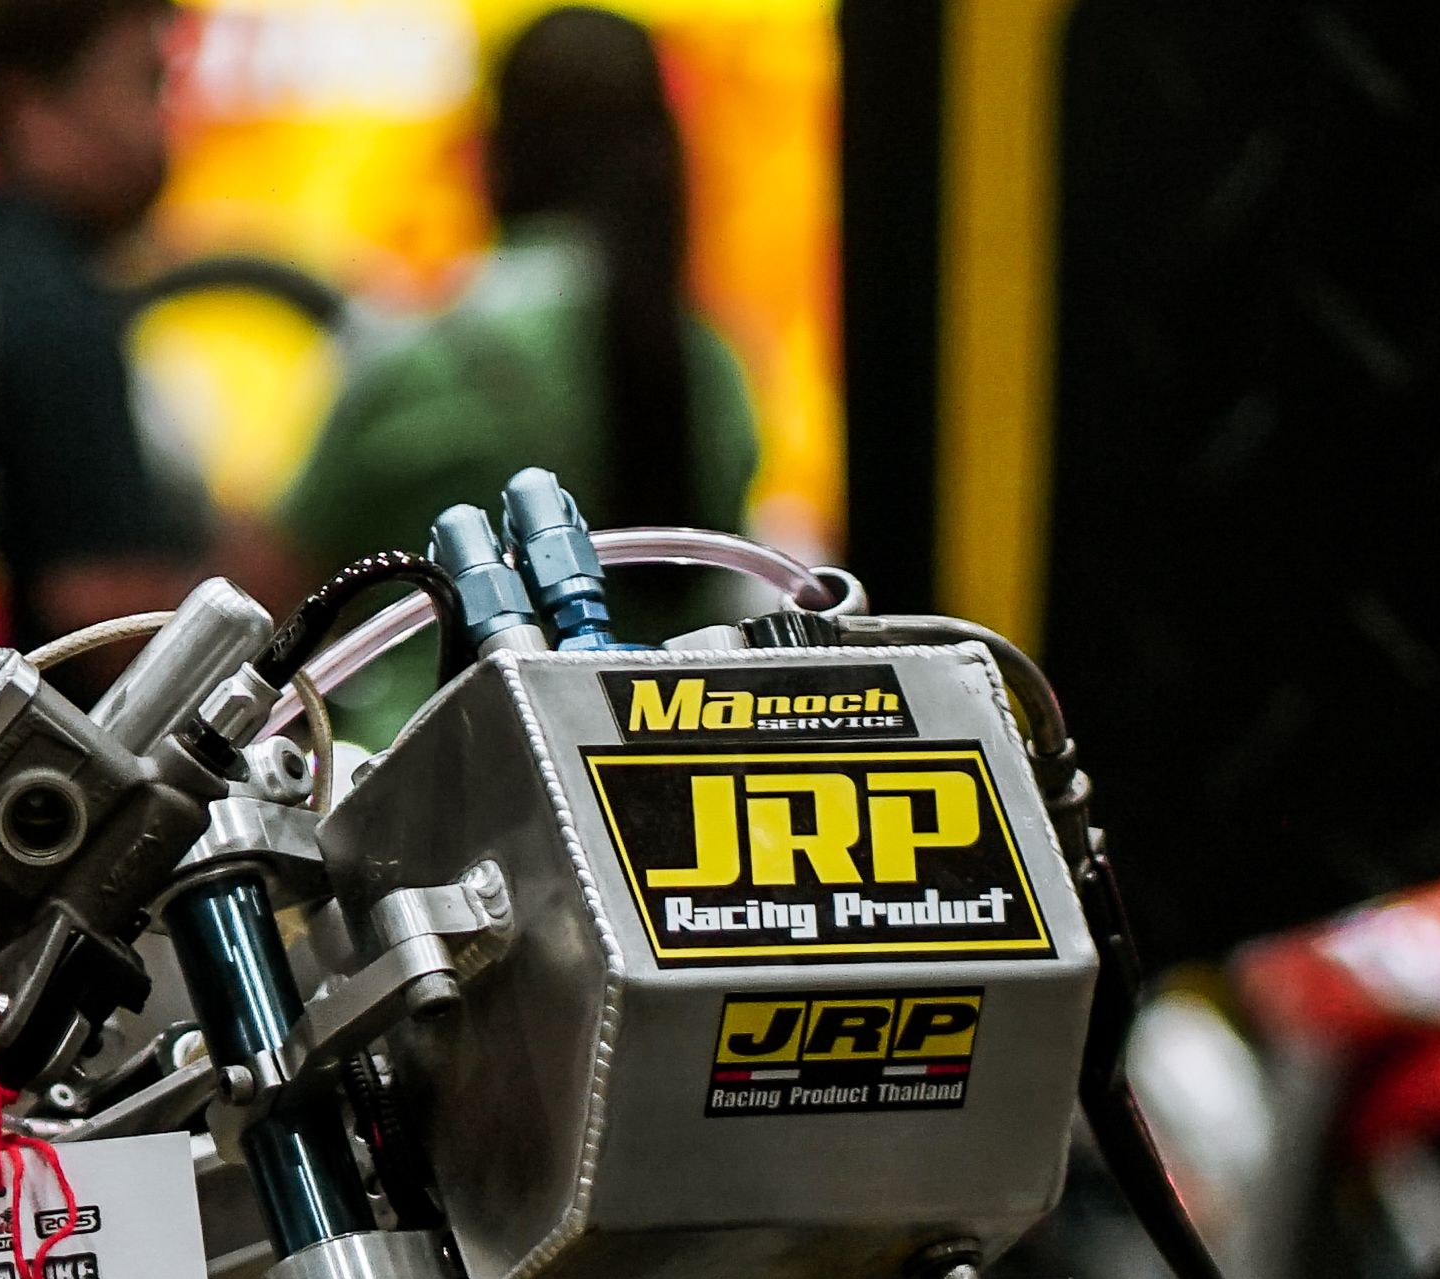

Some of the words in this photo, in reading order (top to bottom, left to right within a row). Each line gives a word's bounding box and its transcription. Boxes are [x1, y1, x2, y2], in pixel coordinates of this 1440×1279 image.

[757, 714, 905, 731] SERVICE
[645, 770, 982, 888] JRP
[666, 896, 818, 939] Racing
[833, 887, 1014, 928] Product
[726, 1003, 977, 1057] JRP
[711, 1089, 781, 1110] Racing
[789, 1084, 869, 1105] Product
[877, 1080, 963, 1102] Thailand
[40, 1209, 98, 1237] 205
